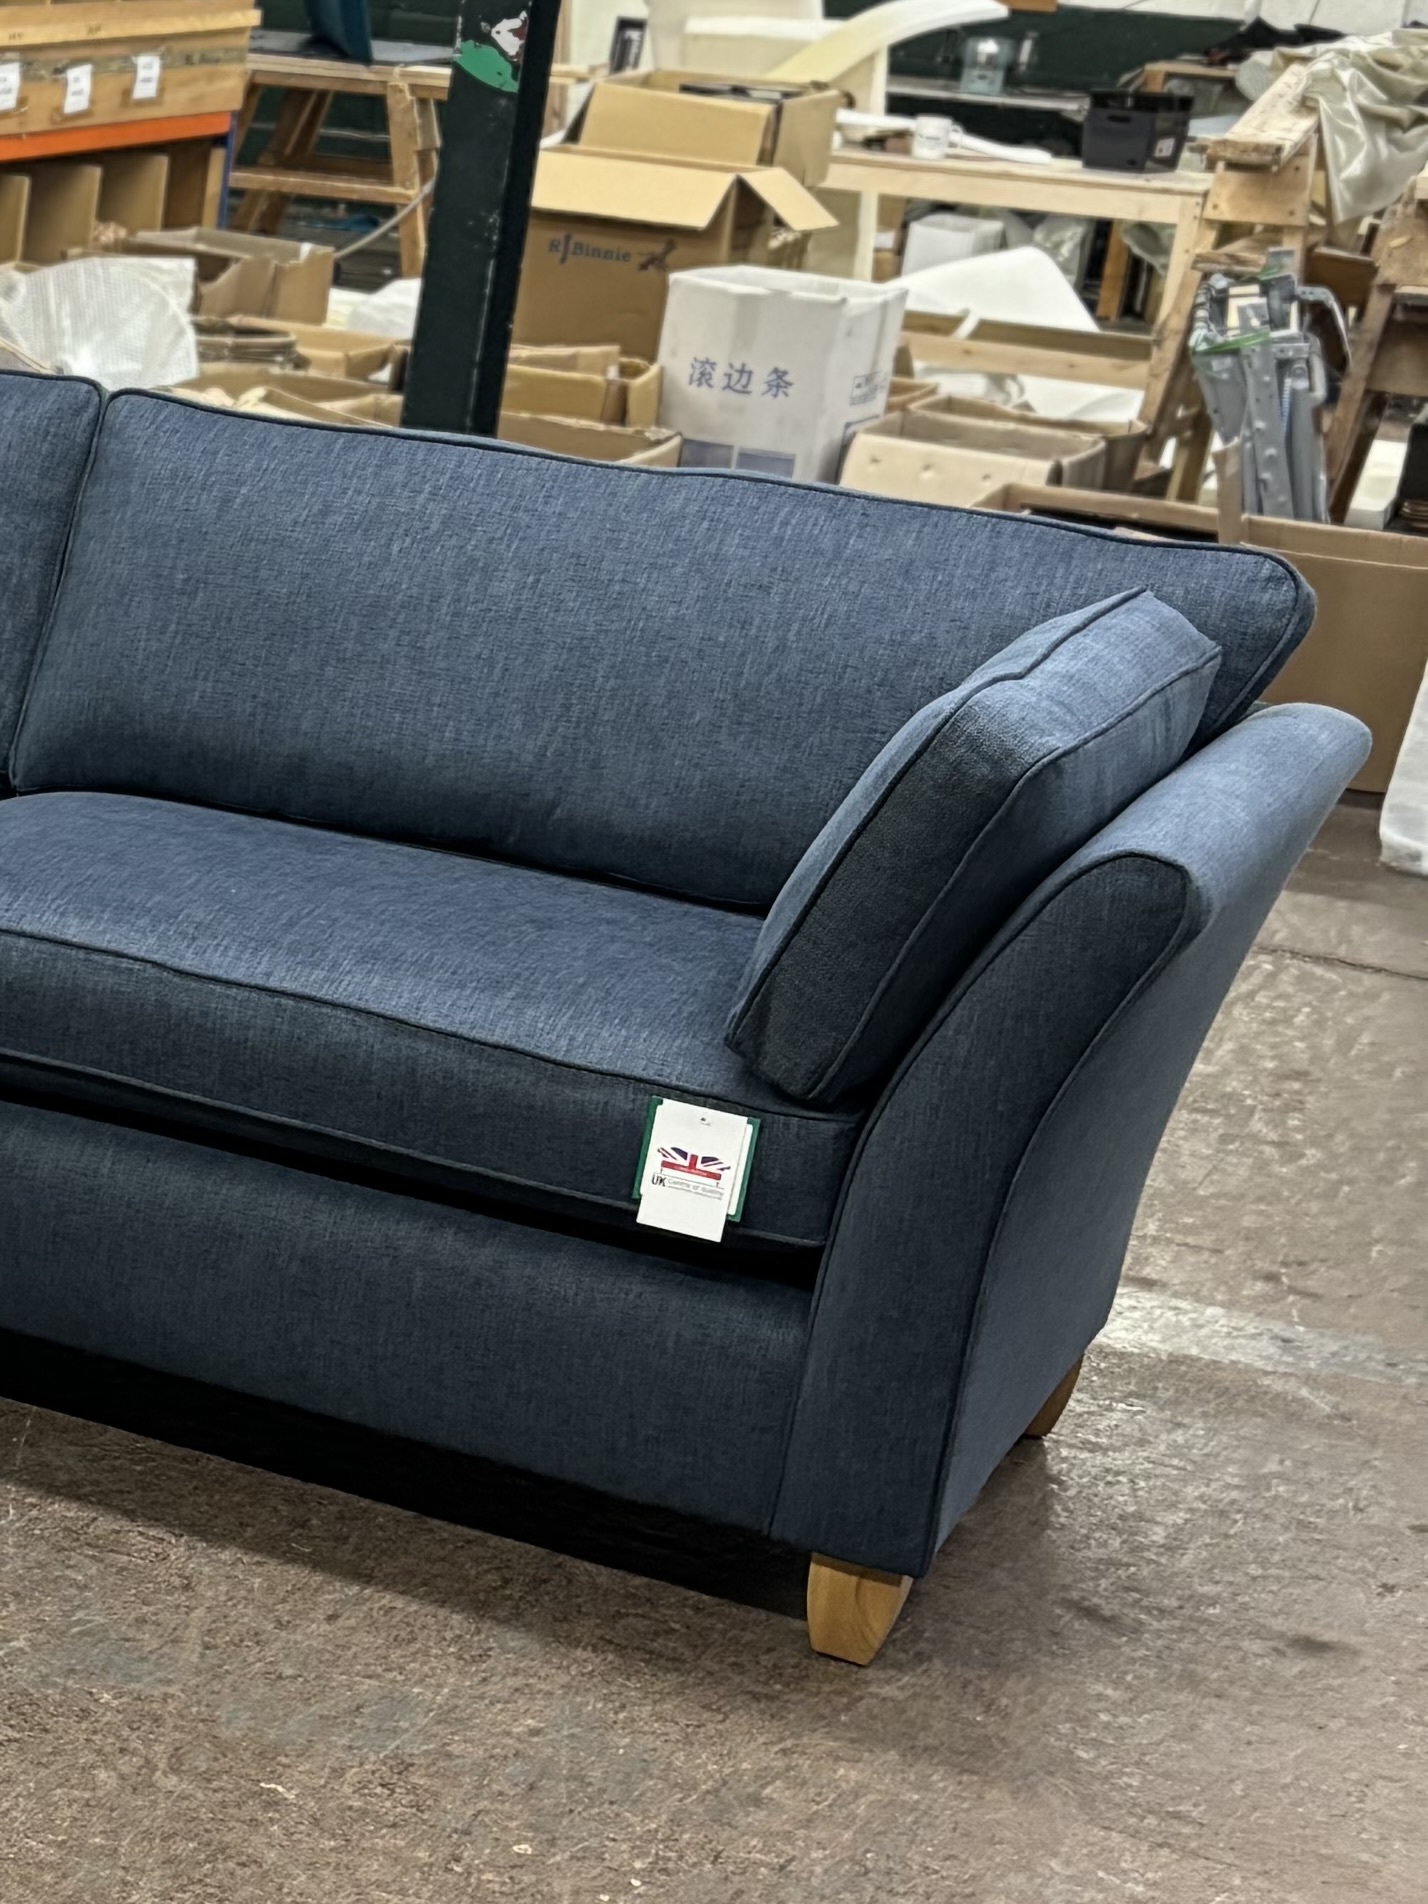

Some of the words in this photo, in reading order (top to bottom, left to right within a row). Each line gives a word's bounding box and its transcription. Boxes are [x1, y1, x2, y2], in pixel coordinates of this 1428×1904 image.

[689, 357, 794, 399] 滚边条
[651, 1172, 667, 1187] UK
